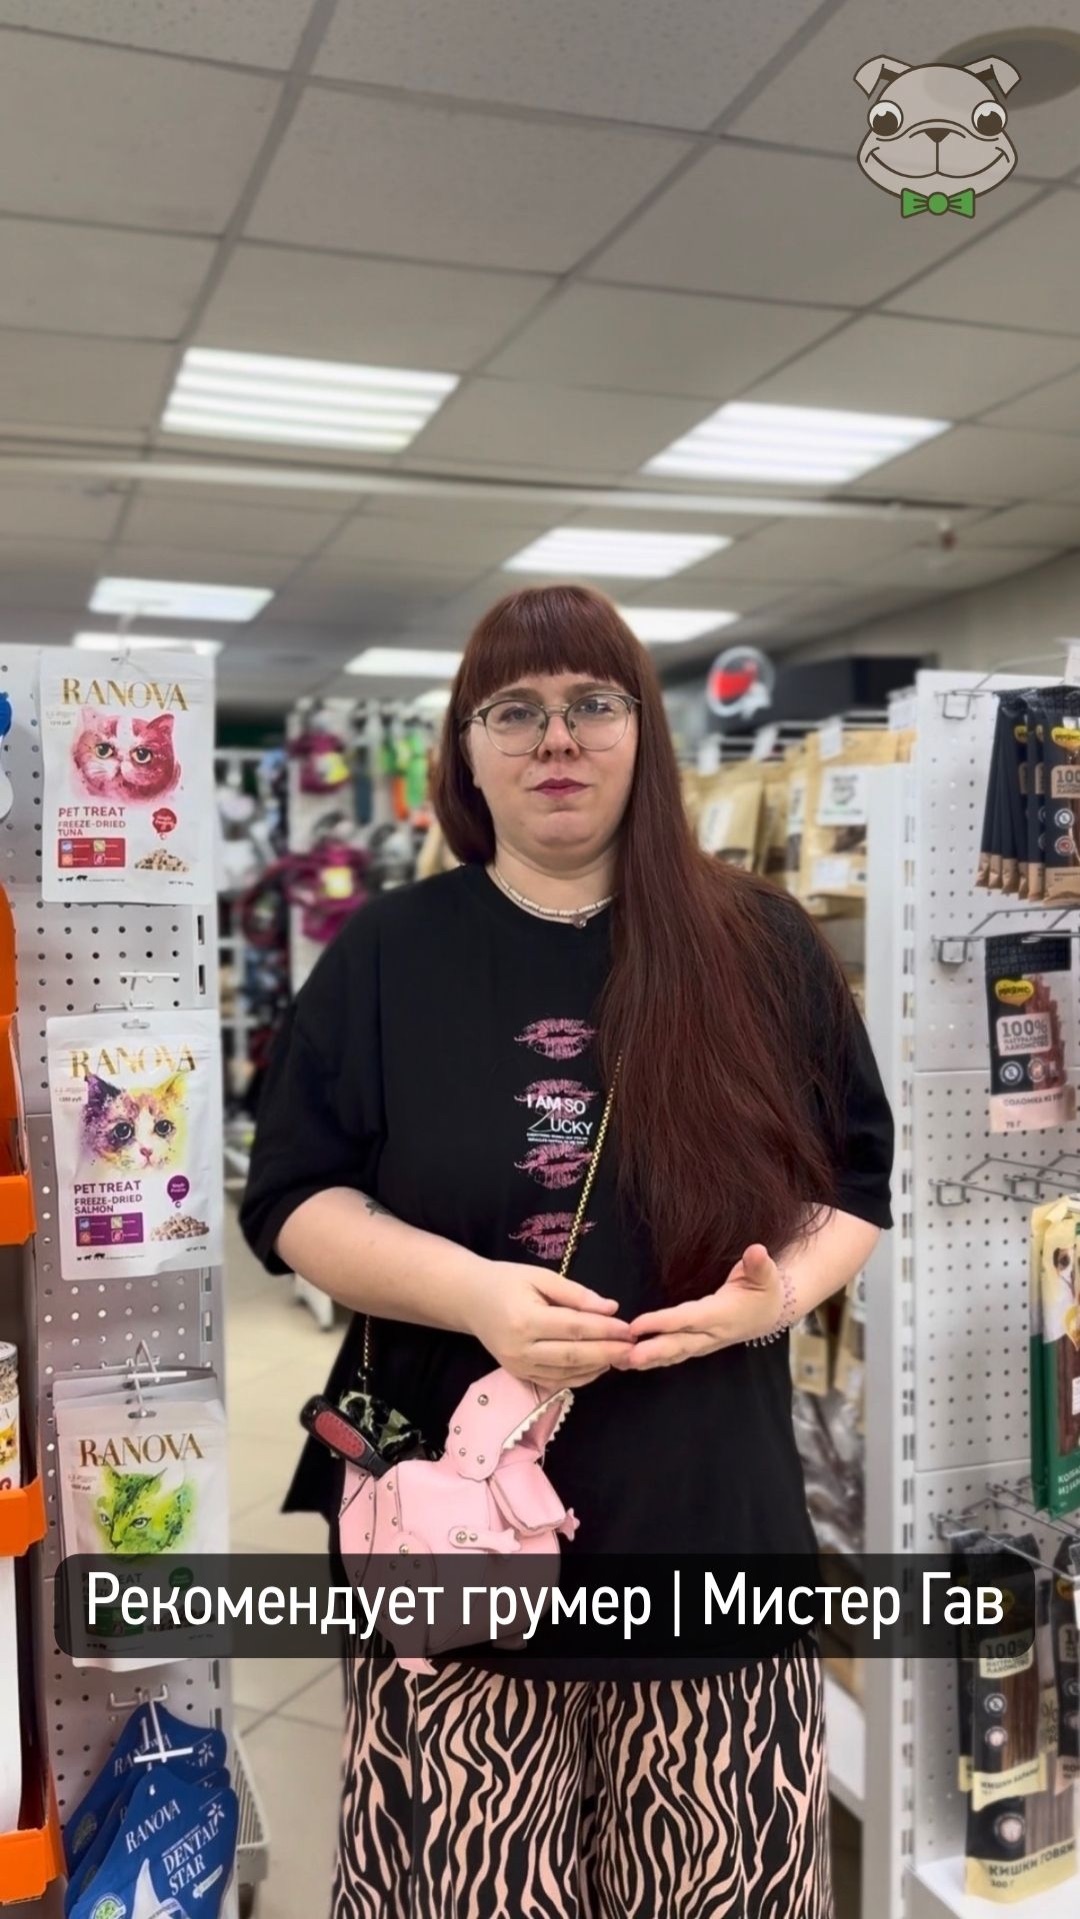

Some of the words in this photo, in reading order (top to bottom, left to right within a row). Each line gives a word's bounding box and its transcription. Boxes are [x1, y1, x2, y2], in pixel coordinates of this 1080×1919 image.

[62, 678, 189, 711] RANOVA
[58, 807, 80, 817] PET
[83, 806, 126, 817] TREAT
[57, 819, 126, 829] FREEZE-DRIED
[57, 829, 84, 837] TUNA
[1001, 1019, 1048, 1038] 100%
[70, 1043, 196, 1078] RANOVA
[527, 1094, 532, 1109] I
[535, 1095, 561, 1111] AM
[564, 1098, 586, 1115] SO
[74, 1183, 97, 1195] PET
[99, 1180, 142, 1194] TREAT
[74, 1194, 143, 1206] FREEZE-DRIED
[74, 1205, 114, 1215] SALMON
[79, 1432, 204, 1468] RANOVA
[125, 1799, 181, 1854] RANOVA
[162, 1819, 220, 1876] DENTAL
[168, 1854, 206, 1896] STAR
[989, 1859, 1039, 1877] КИШКИ
